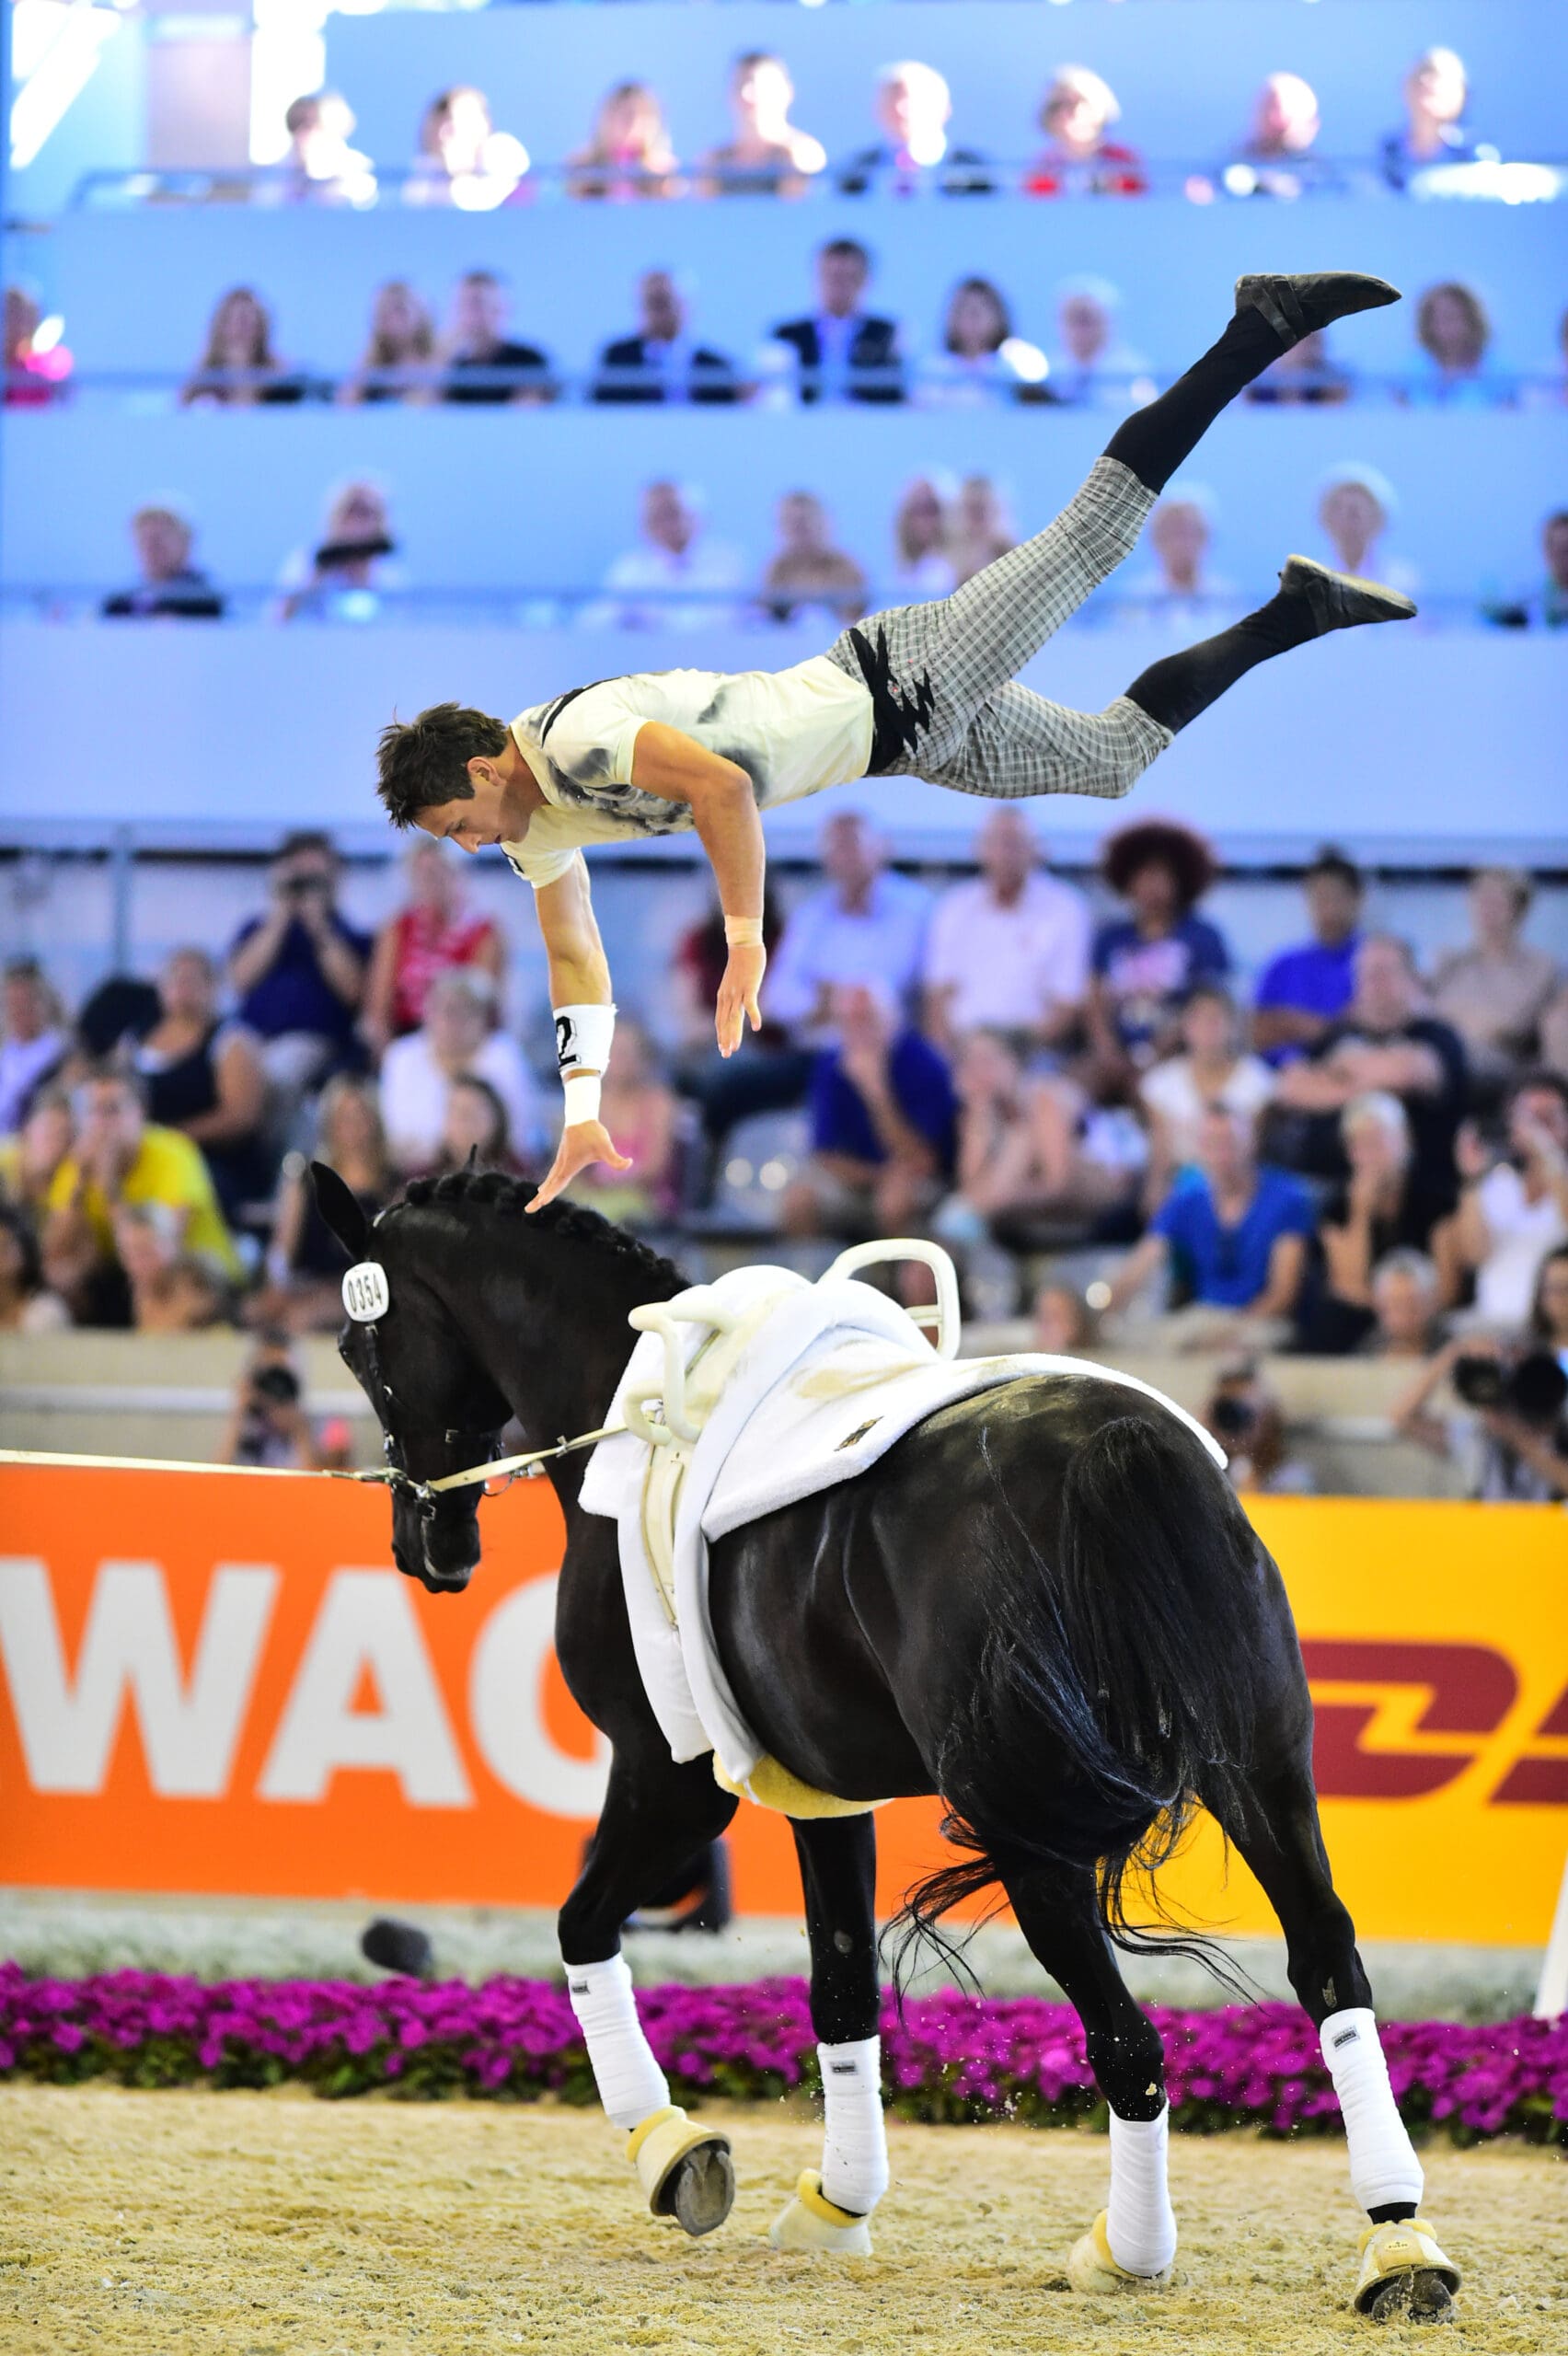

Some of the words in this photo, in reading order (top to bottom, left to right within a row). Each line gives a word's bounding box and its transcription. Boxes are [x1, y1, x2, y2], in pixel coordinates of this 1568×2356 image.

[556, 1015, 578, 1068] 2
[347, 1272, 383, 1313] 0354
[1298, 1639, 1568, 1807] D
